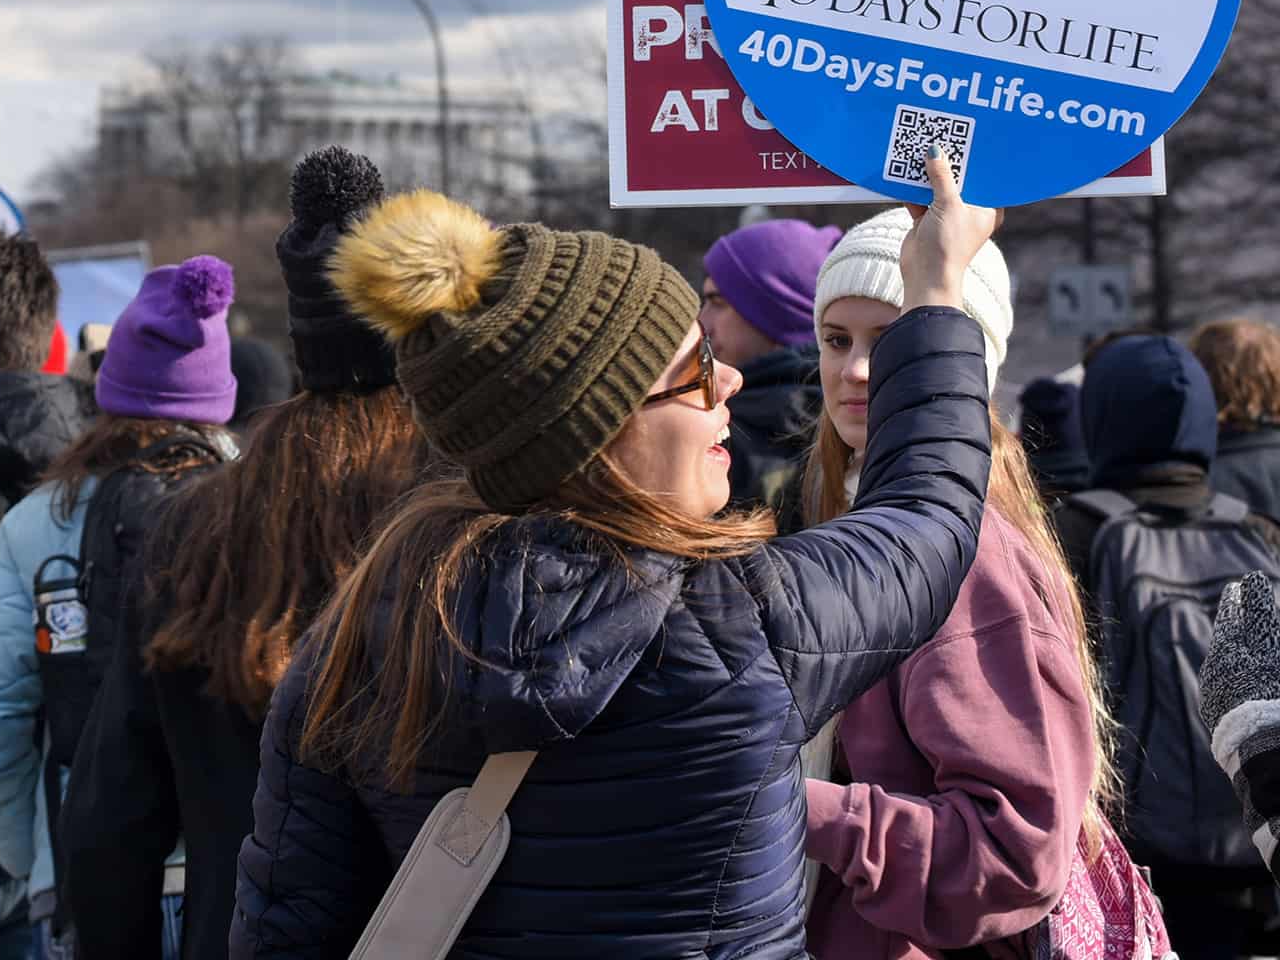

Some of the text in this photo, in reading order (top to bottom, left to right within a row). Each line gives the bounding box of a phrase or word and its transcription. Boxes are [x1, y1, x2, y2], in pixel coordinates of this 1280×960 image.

[1052, 17, 1160, 73] LIFE
[650, 89, 730, 133] AT
[738, 29, 1146, 137] 40DaysForLife.com
